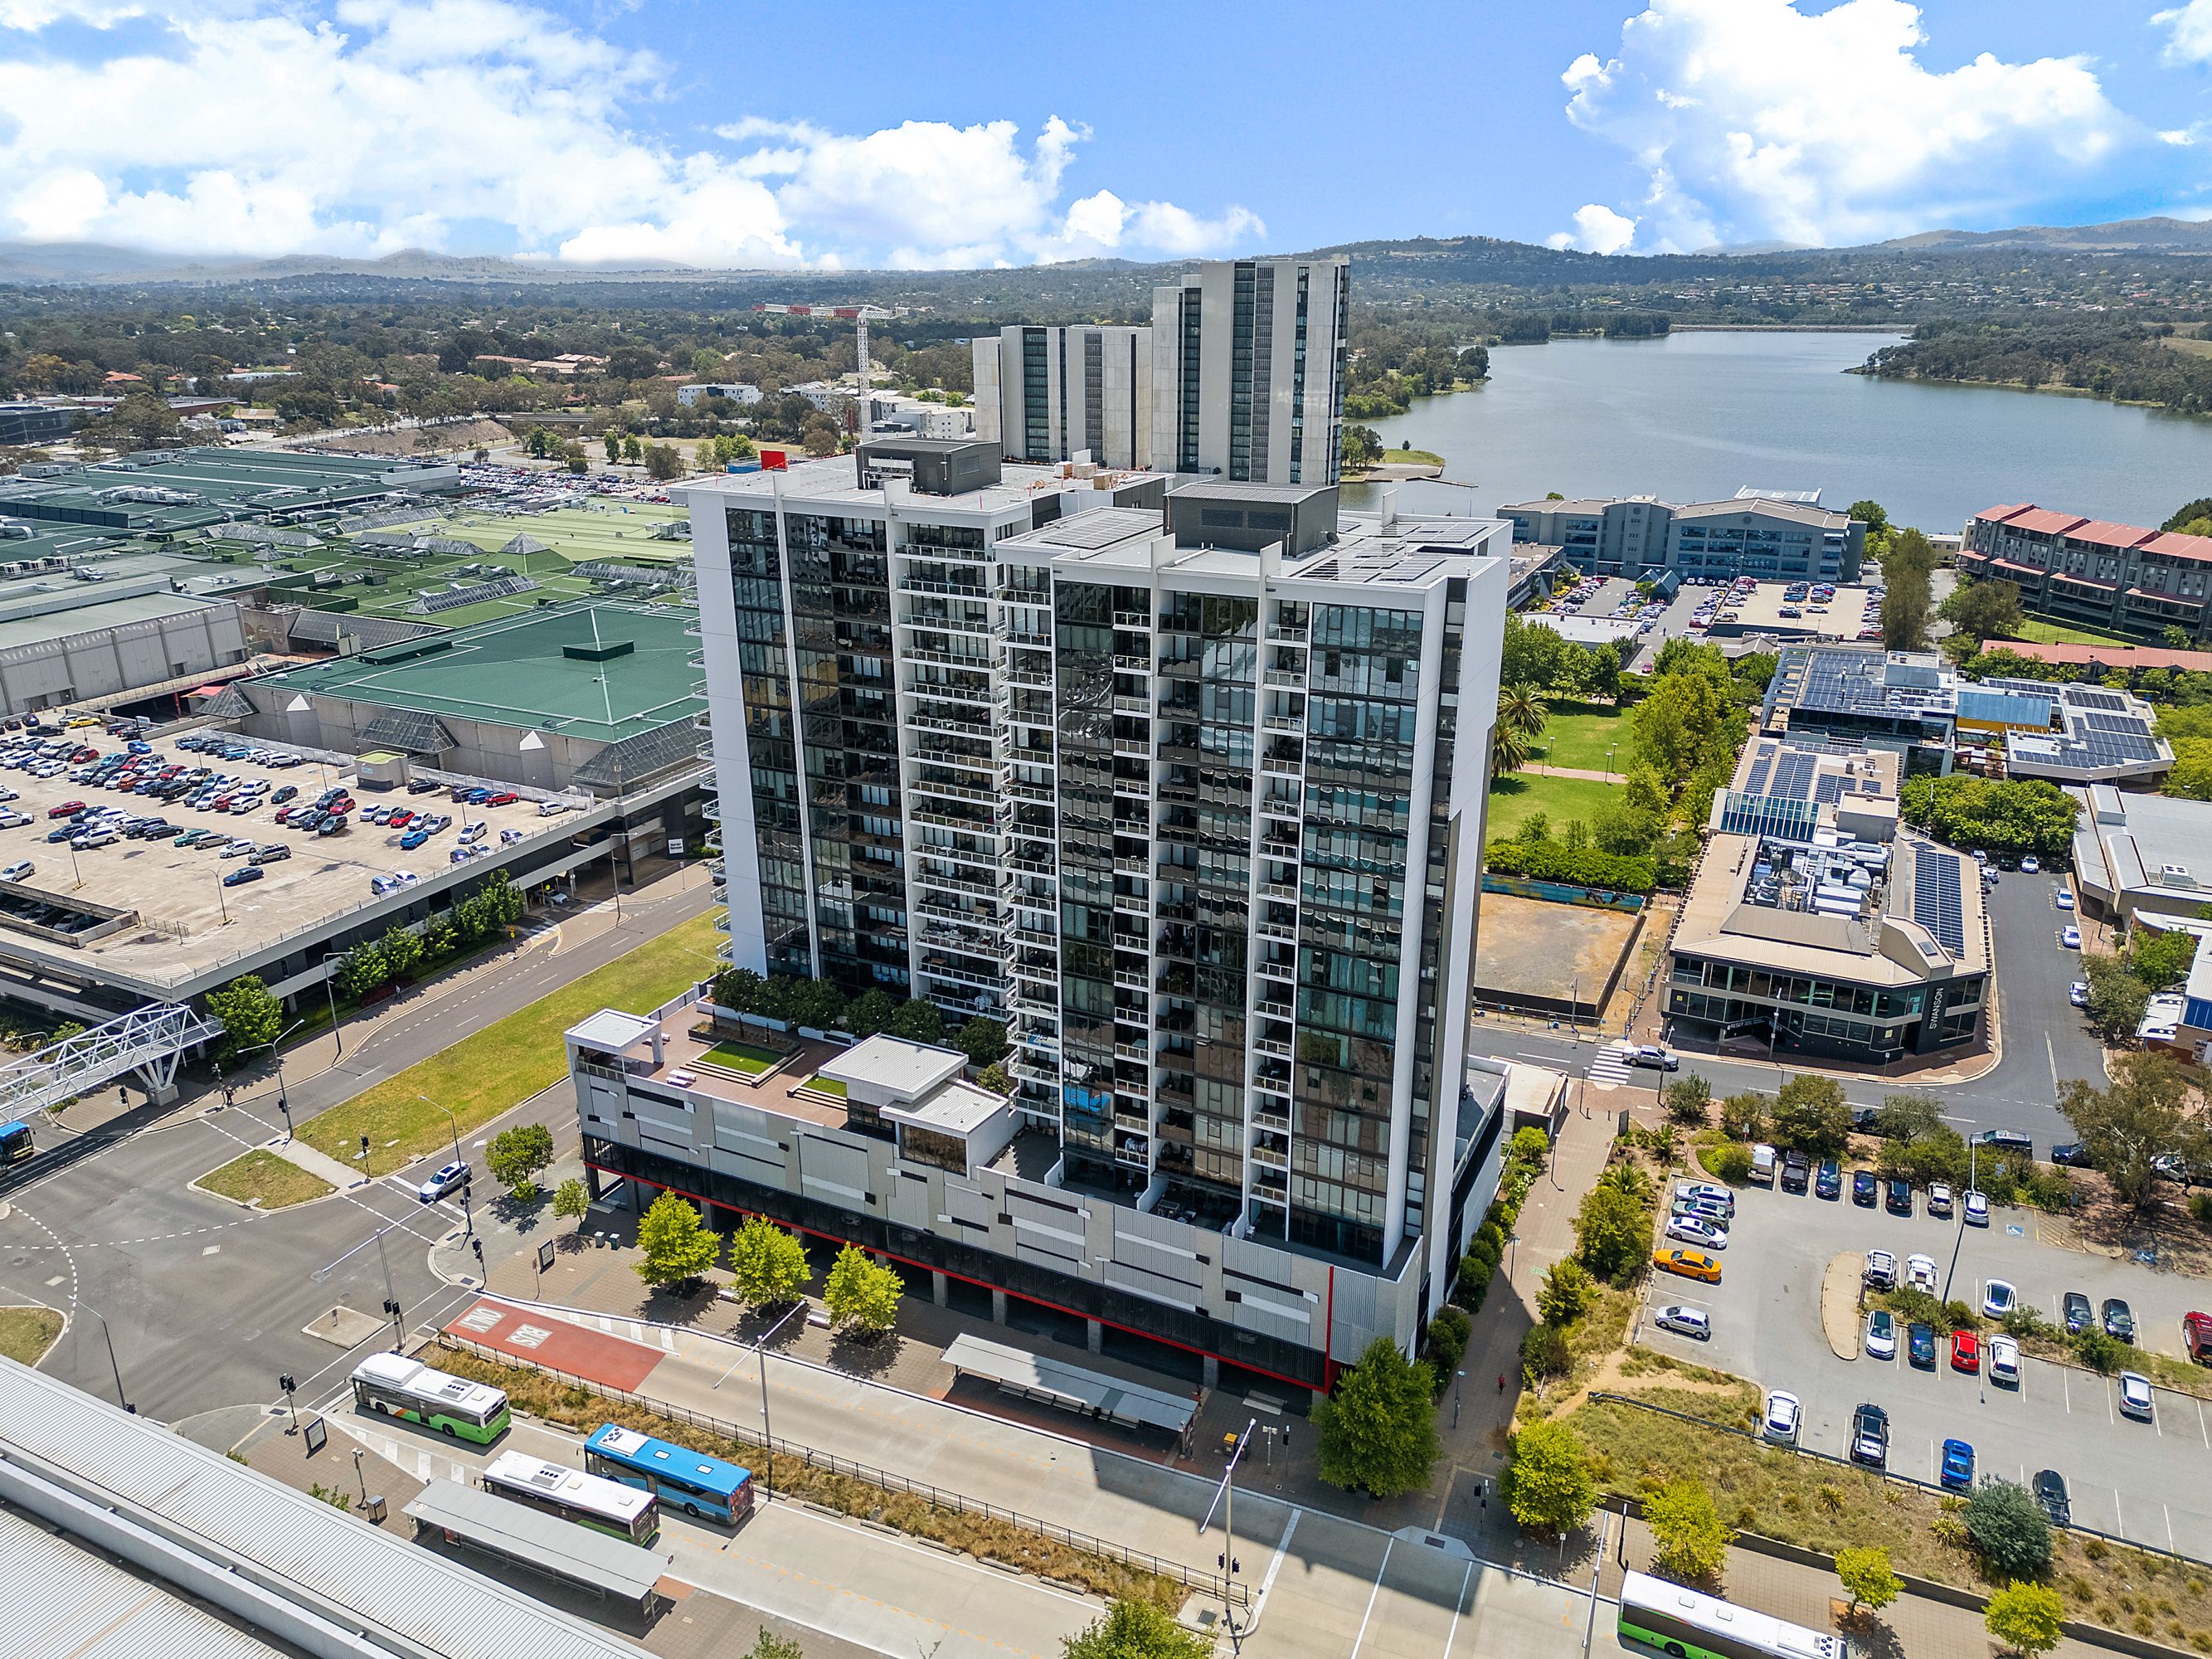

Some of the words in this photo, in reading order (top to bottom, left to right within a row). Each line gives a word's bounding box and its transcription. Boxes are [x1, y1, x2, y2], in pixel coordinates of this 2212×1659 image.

[1929, 987, 1944, 1029] SWANSON
[461, 1307, 503, 1332] ONLY
[509, 1325, 550, 1346] BUS
